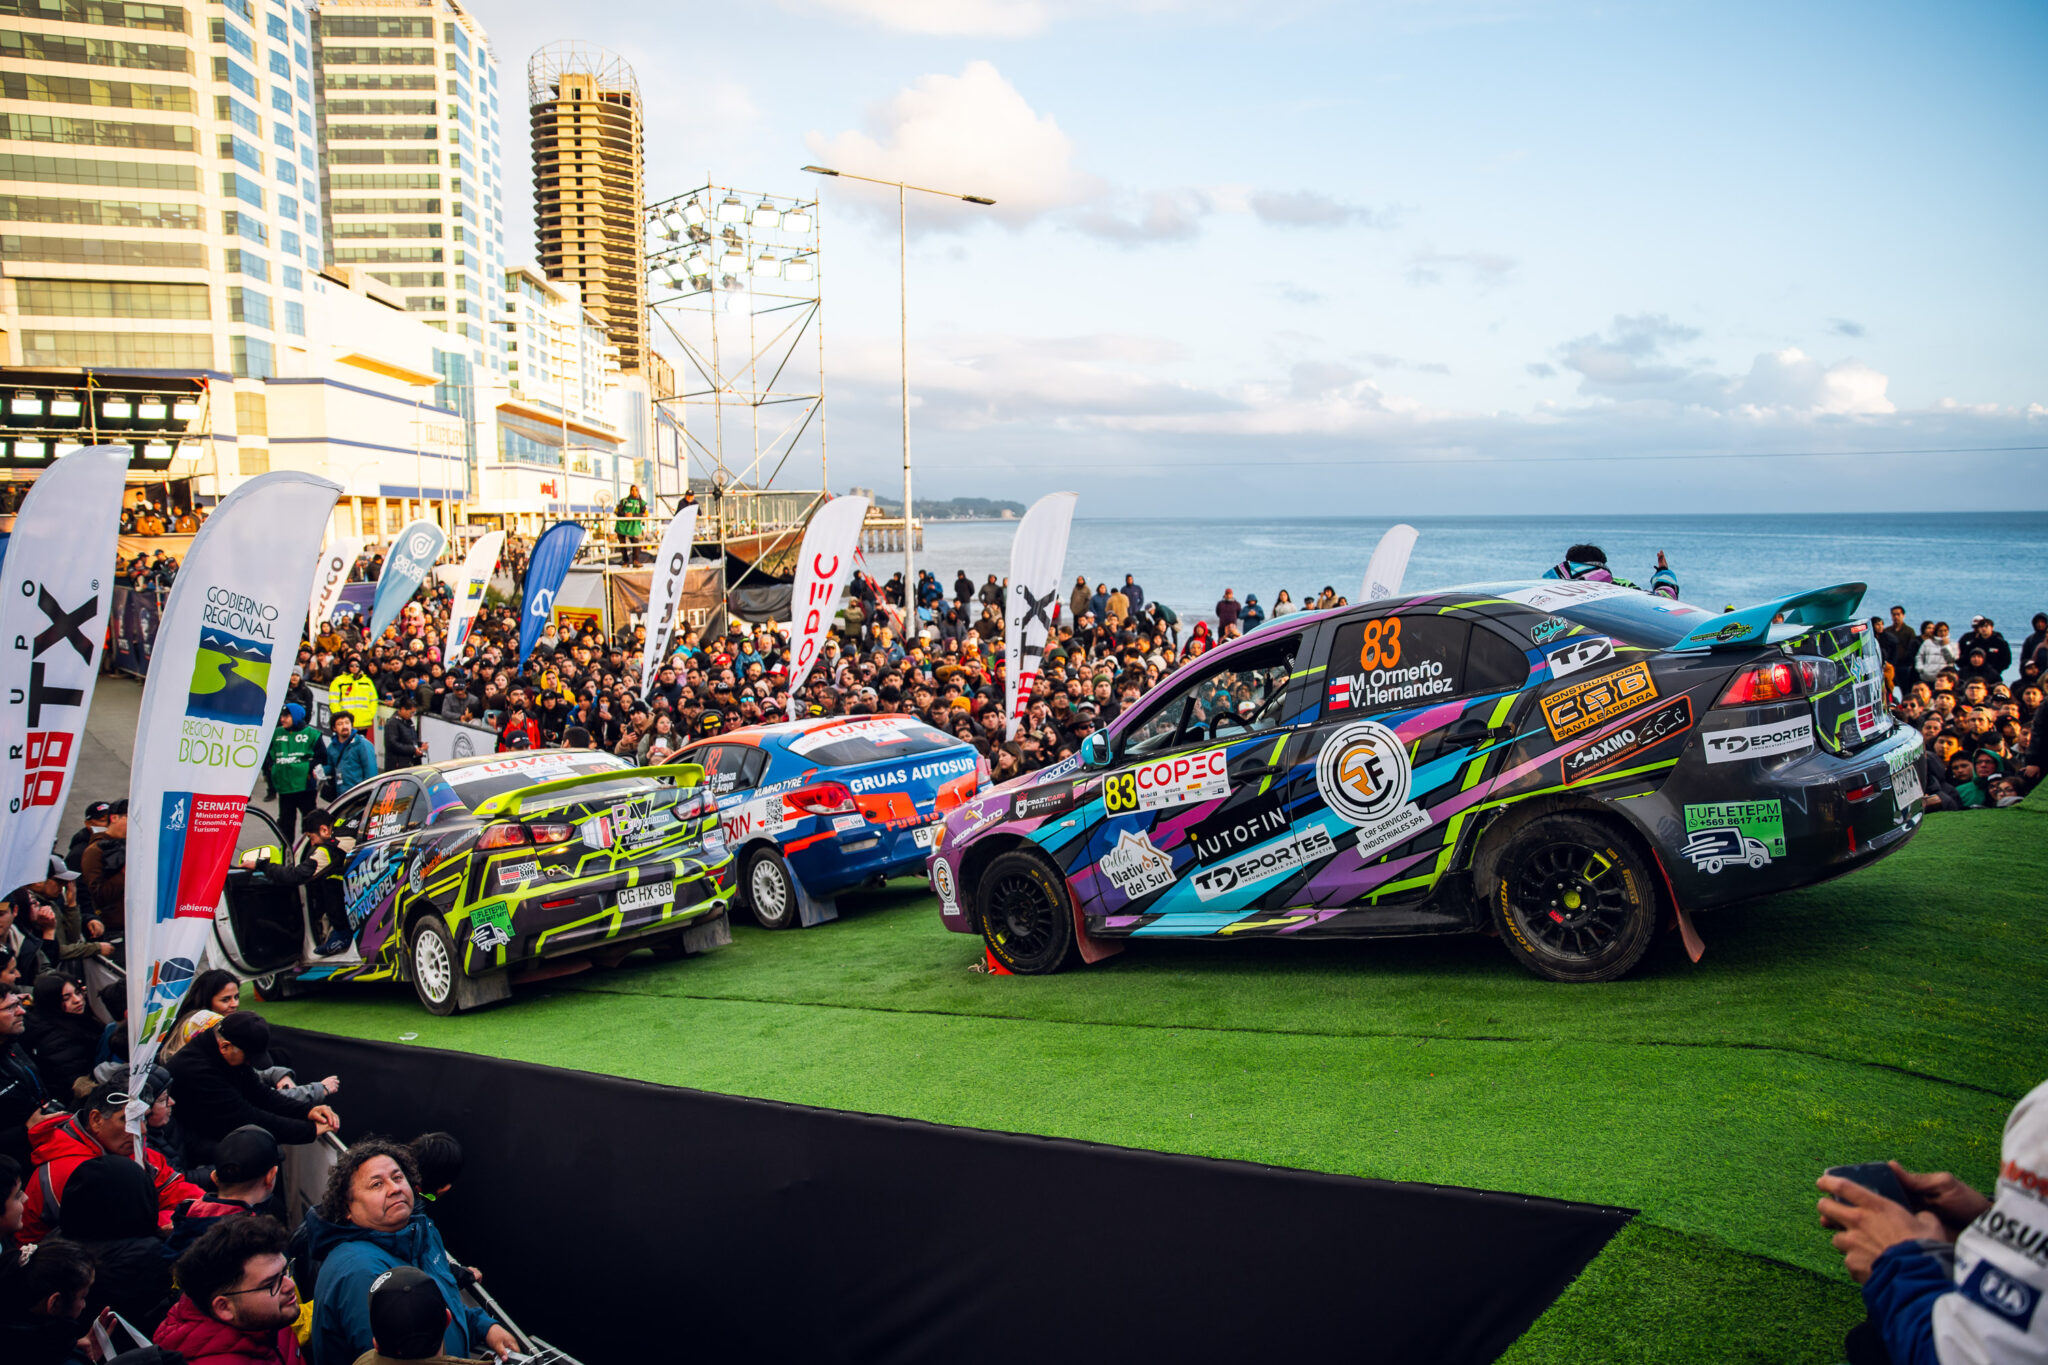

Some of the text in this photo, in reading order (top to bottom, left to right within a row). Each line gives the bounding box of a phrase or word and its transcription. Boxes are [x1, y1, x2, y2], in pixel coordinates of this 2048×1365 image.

[207, 586, 279, 621] GOBIERNO
[202, 604, 275, 639] REGIONAL
[1360, 616, 1402, 671] 83
[1350, 659, 1443, 692] M.Ormeño
[1544, 665, 1643, 706] CONSTRUCTORA
[1350, 677, 1453, 708] V.Hernandez
[233, 727, 260, 744] DEL
[825, 719, 897, 738] LUVER
[1557, 717, 1596, 738] SANTA
[483, 754, 575, 773] LUVER
[705, 747, 722, 776] 82
[850, 757, 976, 793] GRUAS AUTOSUR
[1137, 751, 1226, 789] COPEC
[753, 777, 803, 798] KUMHO TYRE
[1105, 773, 1137, 810] 83
[1364, 809, 1412, 839] CRF SERVICIOS
[1687, 803, 1779, 819] TUFLETEPM
[1700, 815, 1780, 827] +569 8617 1477
[1197, 807, 1287, 861] AUTOFIN
[1362, 815, 1425, 851] INDUSTRIALES SPA
[1101, 850, 1133, 874] Pellet
[1111, 855, 1161, 886] Nativos
[358, 873, 396, 920] TUCAPEL
[1128, 870, 1169, 897] del Sur
